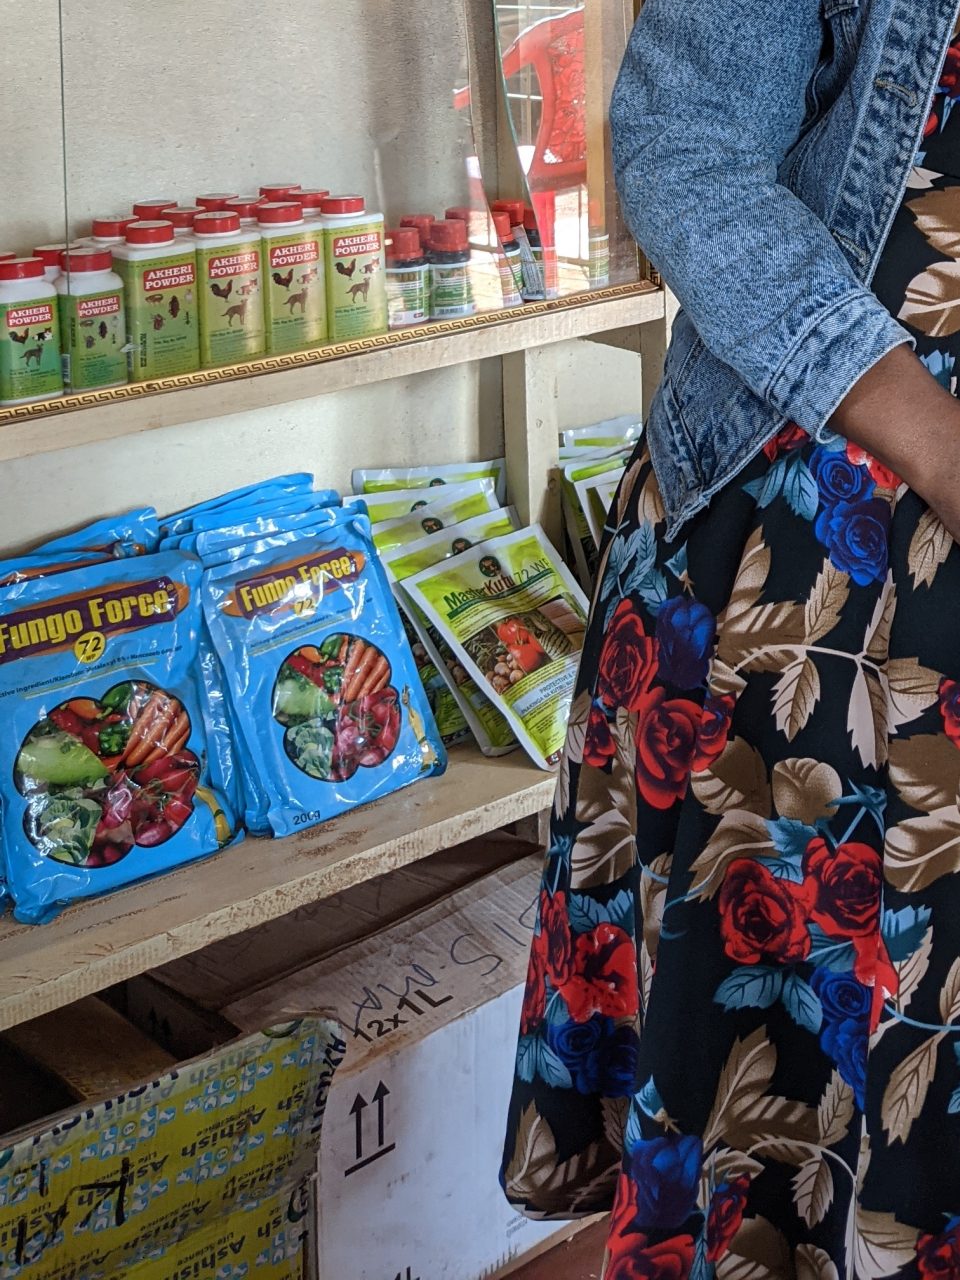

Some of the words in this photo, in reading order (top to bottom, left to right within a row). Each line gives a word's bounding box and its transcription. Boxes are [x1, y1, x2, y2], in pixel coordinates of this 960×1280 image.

[337, 234, 378, 246] AKHERI
[274, 243, 315, 257] AKHERI
[335, 242, 380, 256] POWDER
[212, 253, 256, 267] AKHERI
[272, 252, 317, 266] POWDER
[147, 264, 192, 280] AKHERI
[210, 262, 257, 276] POWDER
[145, 274, 194, 289] POWDER
[79, 304, 119, 317] POWDER
[80, 298, 117, 310] AKHERI
[8, 313, 51, 326] POWDER
[10, 306, 49, 319] AKHERI
[298, 556, 351, 585] Force
[444, 574, 516, 610] MasterKutu
[514, 570, 530, 584] 72
[296, 598, 314, 612] 72
[0, 610, 83, 654] Fungo
[88, 590, 169, 627] Force
[78, 636, 101, 654] 72
[292, 809, 321, 826] 200g
[354, 989, 454, 1042] 12x1L
[182, 1108, 266, 1157] Ashish
[216, 1232, 234, 1245] Life
